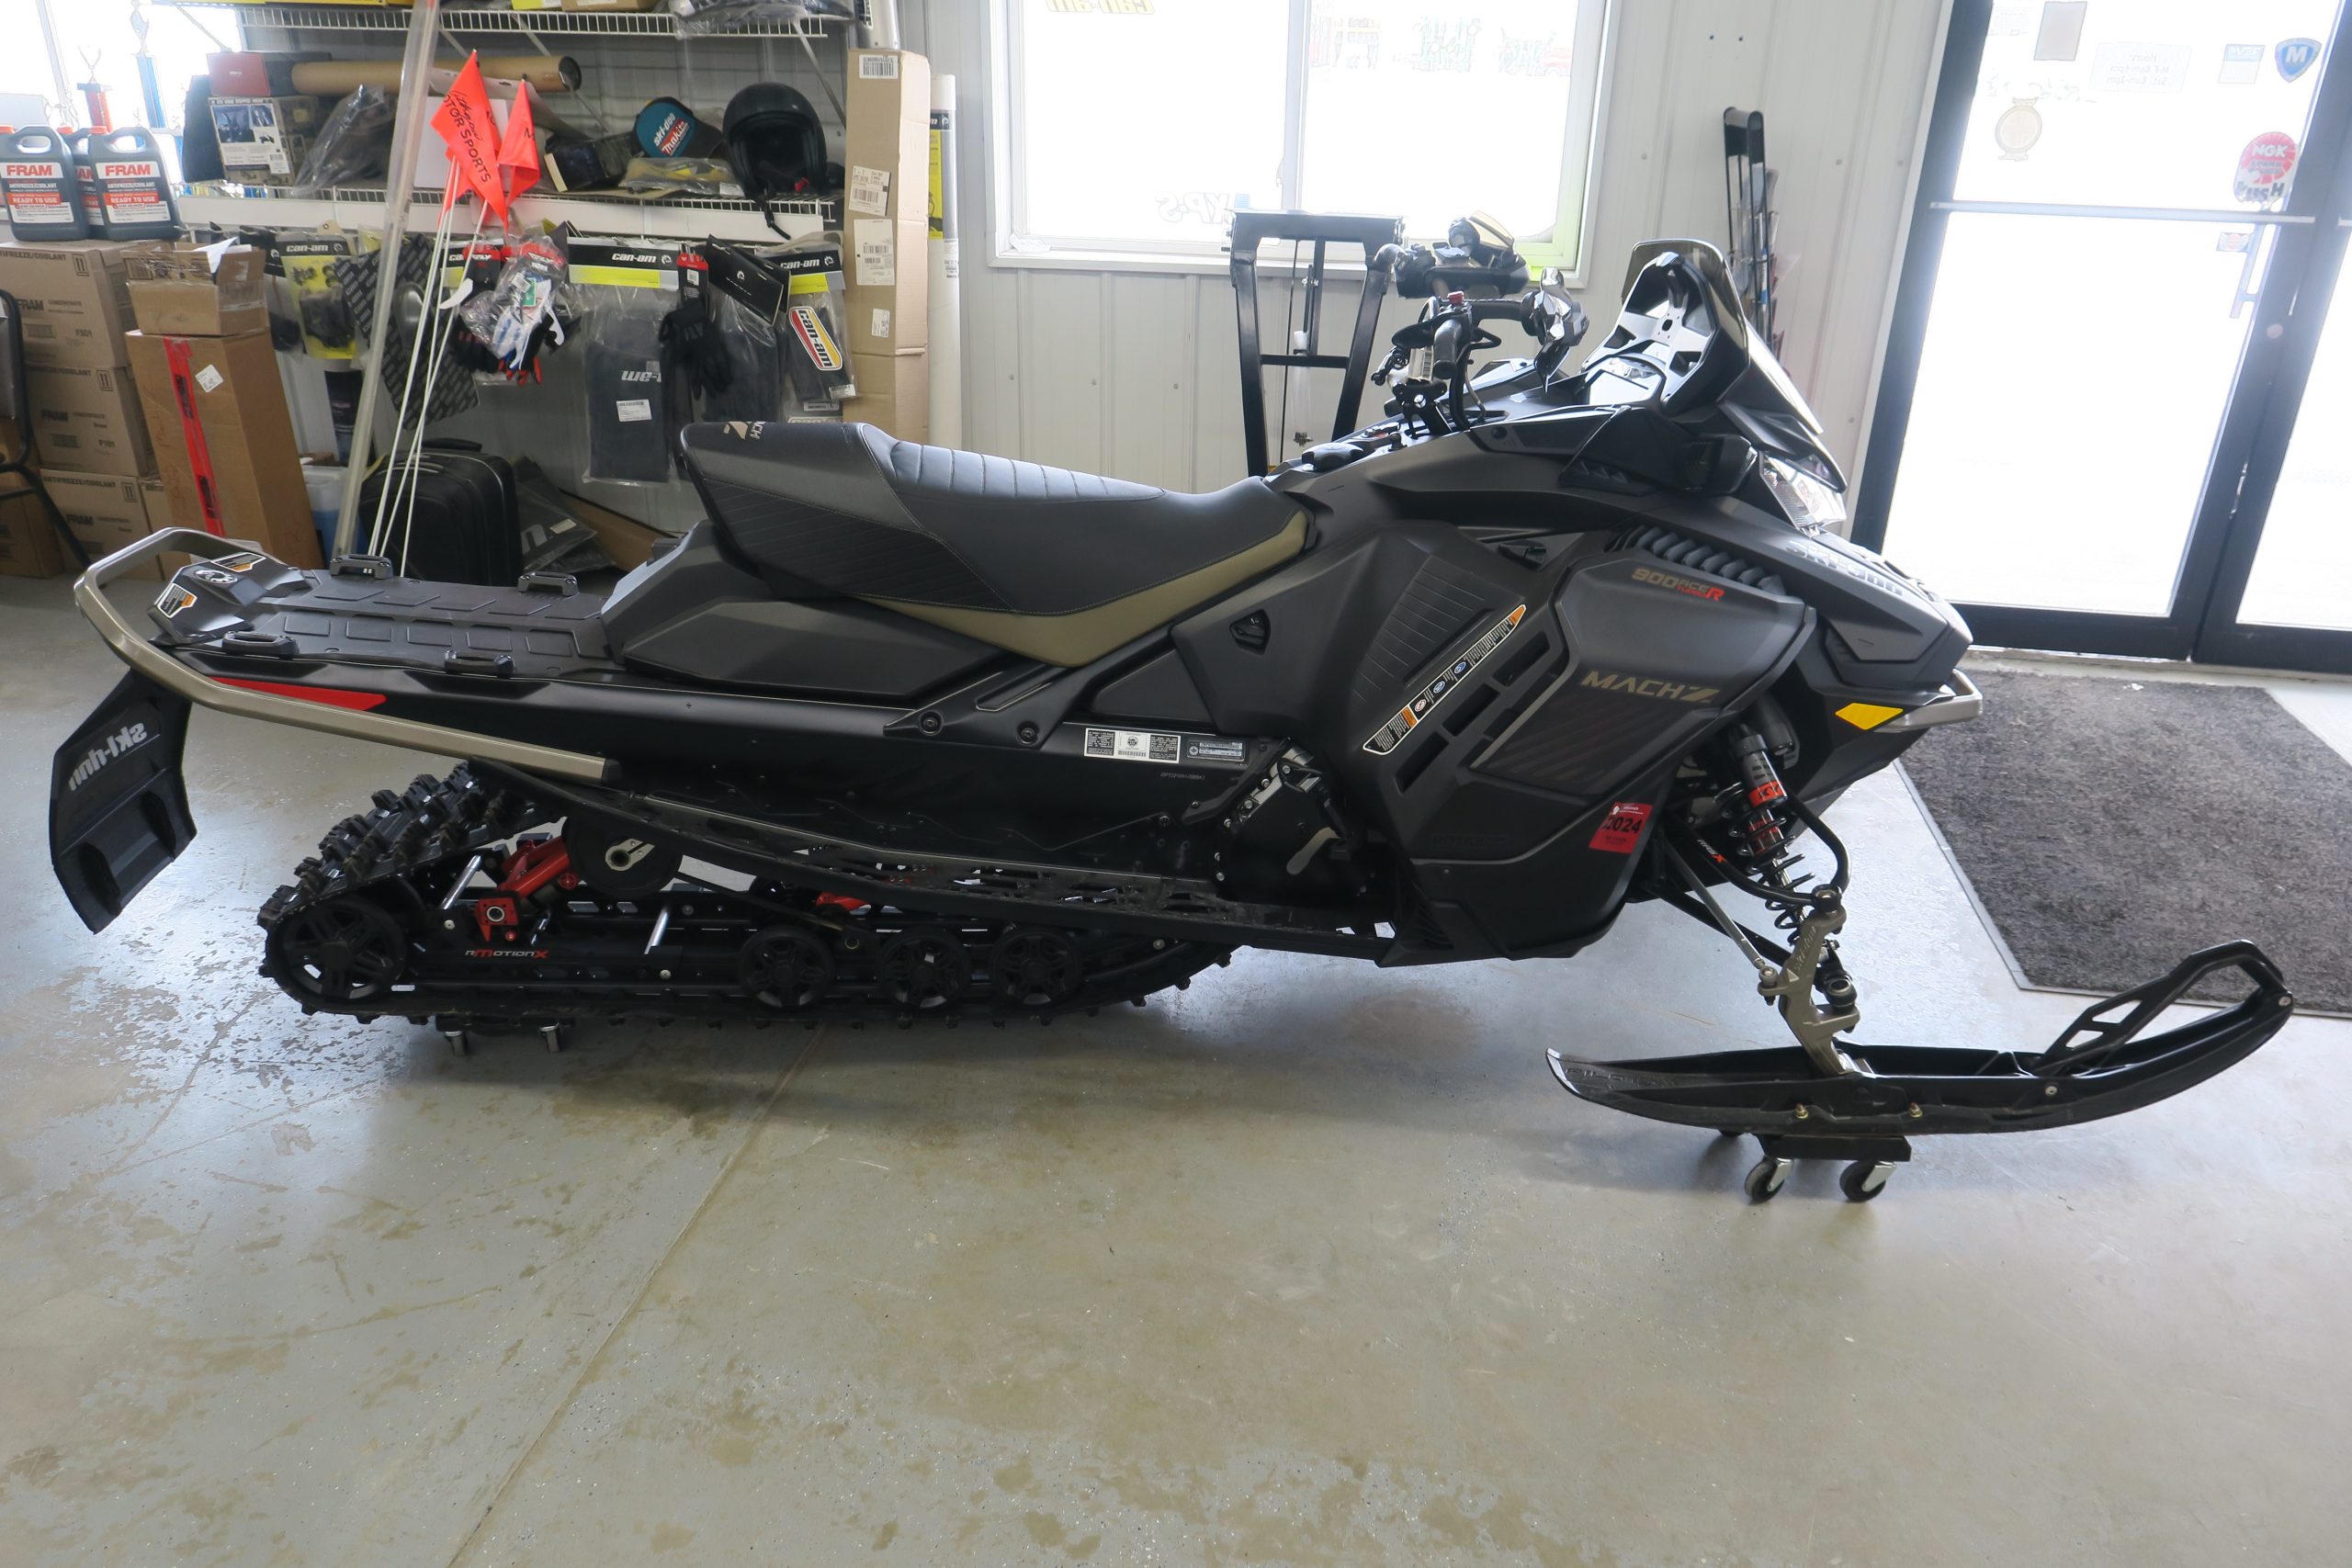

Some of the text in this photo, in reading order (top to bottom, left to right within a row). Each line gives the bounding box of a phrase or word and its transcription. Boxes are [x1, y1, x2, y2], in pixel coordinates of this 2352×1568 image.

[460, 129, 492, 183] SPORTS
[2252, 143, 2288, 158] NGK
[6, 164, 52, 176] FRAM
[105, 164, 151, 176] FRAM
[110, 196, 131, 204] READY
[286, 244, 329, 253] can-am
[611, 253, 657, 264] can-am
[780, 258, 820, 269] can-am
[797, 310, 832, 367] can-am
[1632, 568, 1679, 589] 900
[1706, 586, 1725, 602] R
